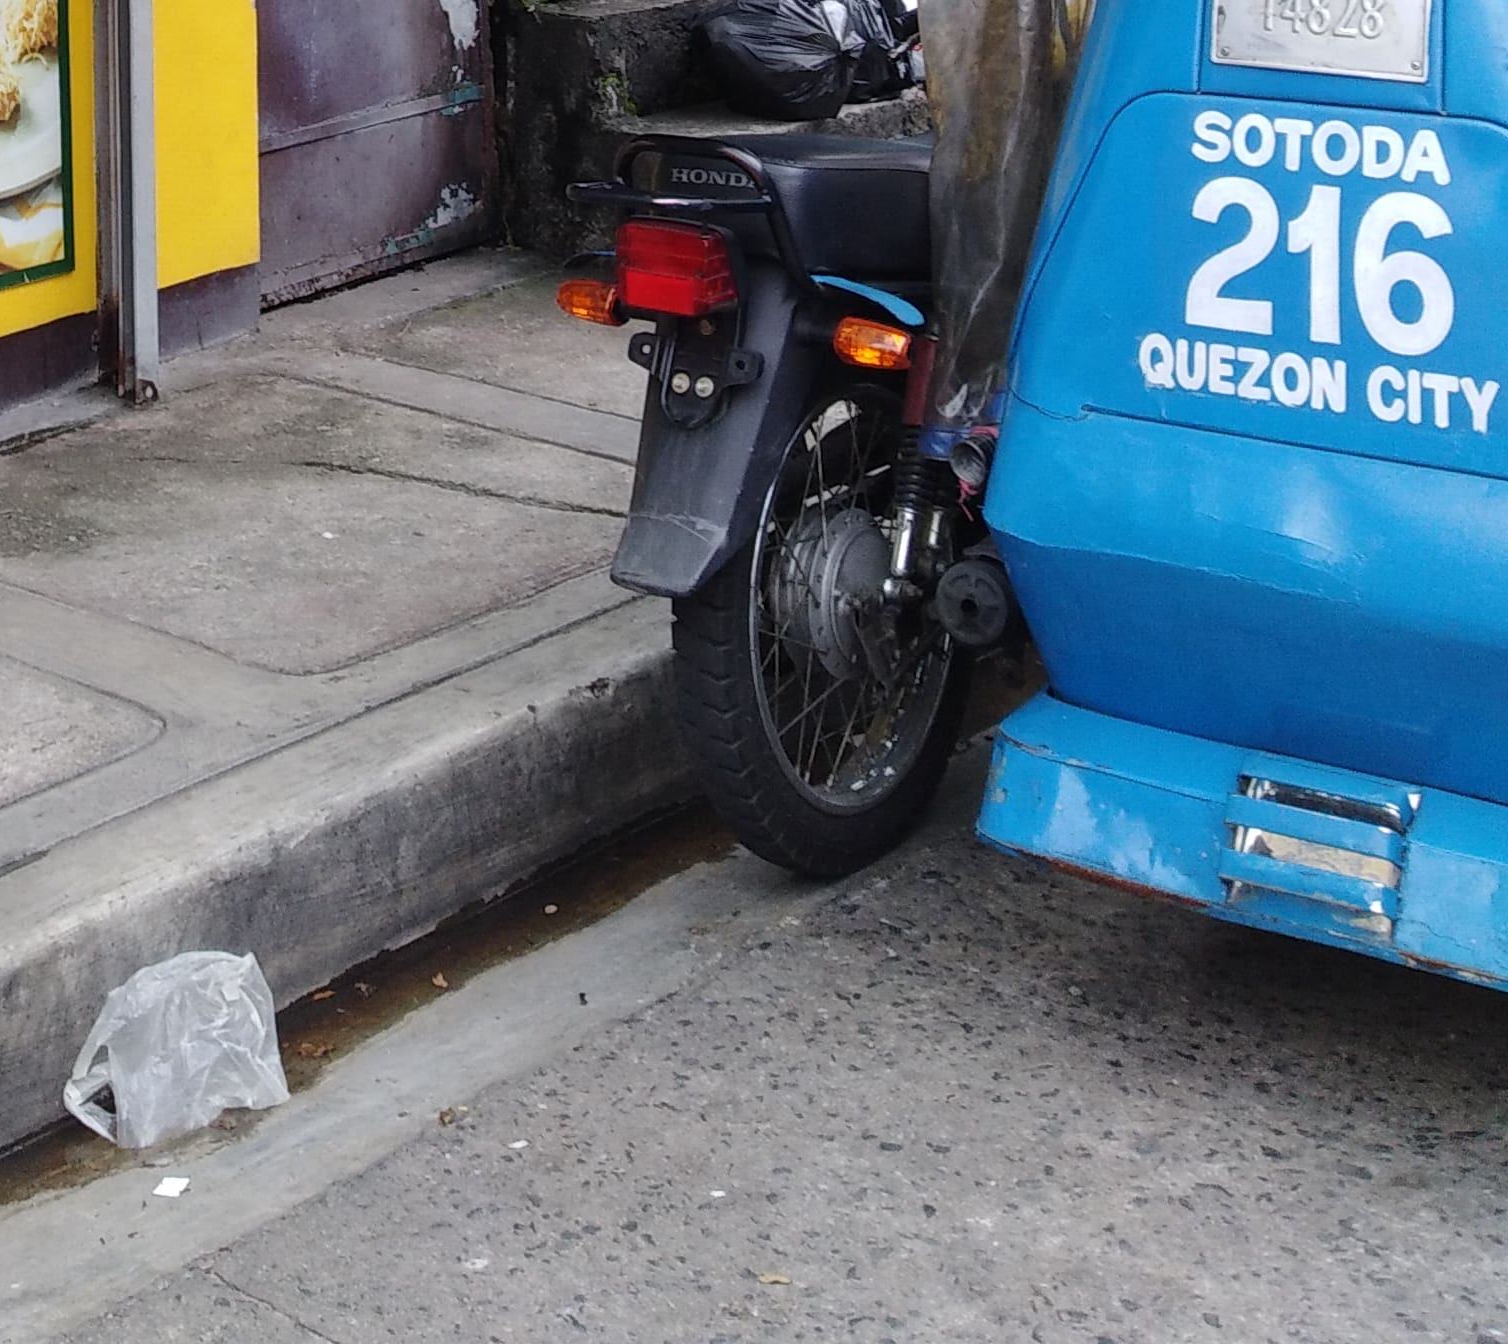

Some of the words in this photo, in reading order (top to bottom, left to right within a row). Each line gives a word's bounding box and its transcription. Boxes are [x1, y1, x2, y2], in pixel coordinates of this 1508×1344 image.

[1190, 110, 1452, 186] SOTODA
[1185, 175, 1455, 356] 216
[1139, 332, 1347, 414] QUEZON
[1366, 365, 1500, 434] CITY
